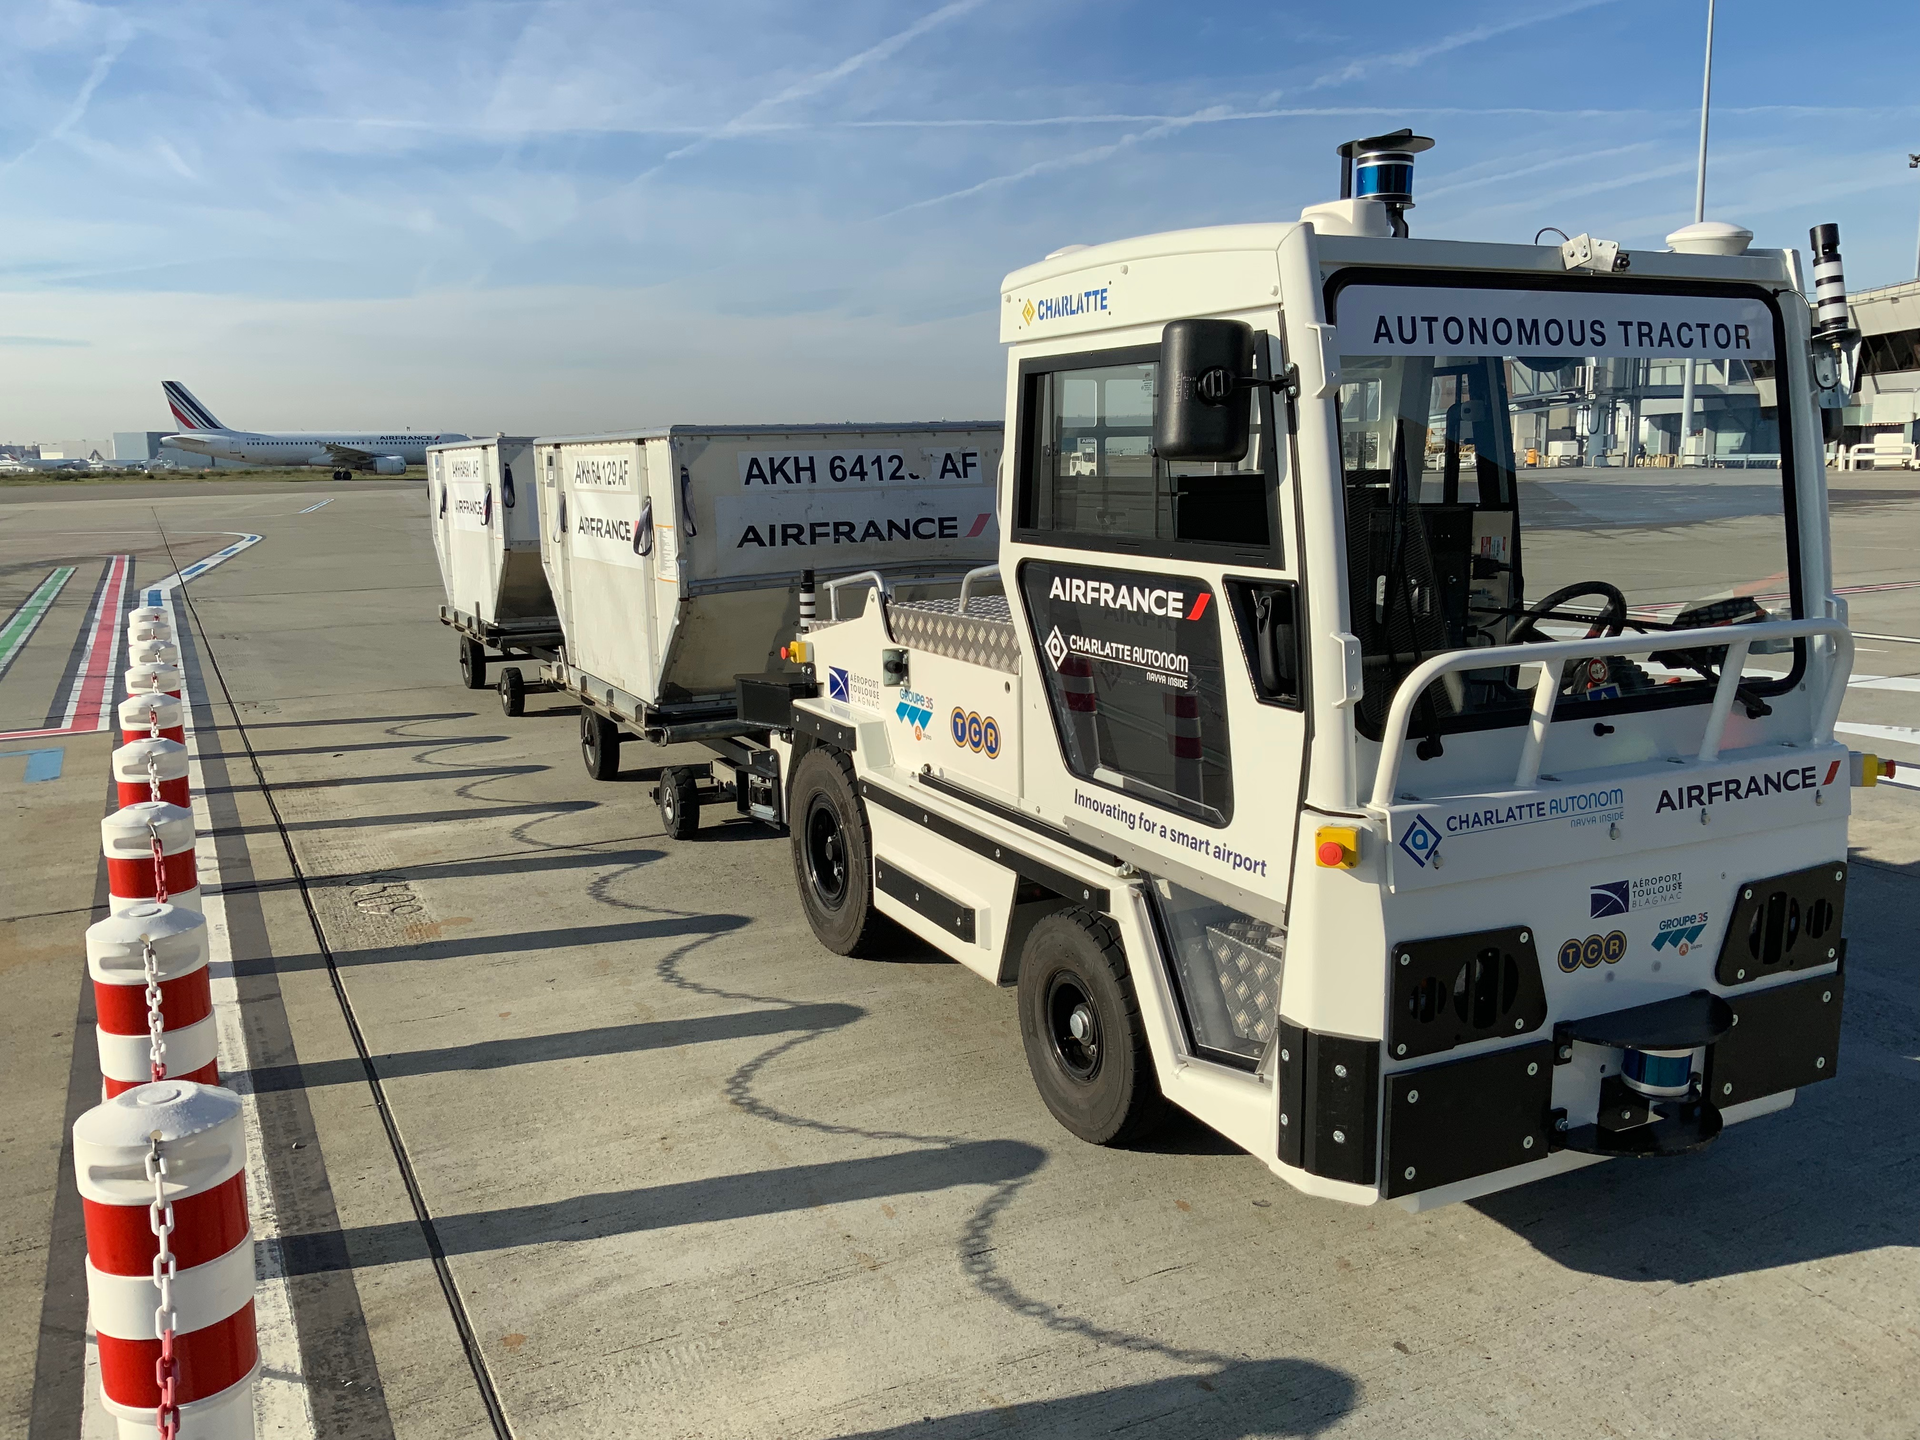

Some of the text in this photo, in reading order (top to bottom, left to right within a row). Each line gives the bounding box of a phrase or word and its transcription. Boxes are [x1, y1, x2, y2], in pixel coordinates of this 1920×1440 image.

[1037, 287, 1108, 321] CHARLATTE
[1372, 314, 1752, 351] AUTONOMOUS TRACTOR
[574, 460, 591, 485] AKH
[617, 459, 629, 486] AF
[743, 452, 978, 486] AKH 6412 AF
[455, 499, 483, 515] AIRFRANCE
[577, 515, 632, 543] AIRFRANCE
[736, 516, 959, 549] AIRFRANCE
[1049, 576, 1184, 619] AIRFRANCE
[1069, 634, 1189, 674] CHARLATTE AUTONOM
[850, 672, 880, 690] AÉROPORT
[850, 683, 880, 700] TOULOUSE
[1146, 671, 1188, 690] NAVYA INSIDE
[850, 693, 880, 710] BLAGNAC
[925, 696, 934, 710] 3S
[953, 713, 998, 752] TCR
[1655, 766, 1817, 814] AIRFRANCE
[1446, 788, 1624, 832] CHARLATTE AUTONOM
[1570, 811, 1625, 828] NAVYA INSIDE
[1074, 788, 1267, 878] Innovating for a smart airport
[1632, 872, 1682, 889] AÉROPORT
[1632, 881, 1682, 899] TOULOUSE
[1632, 891, 1682, 908] BLAGNAC
[1697, 911, 1709, 923] 3S
[1563, 936, 1623, 970] TCR
